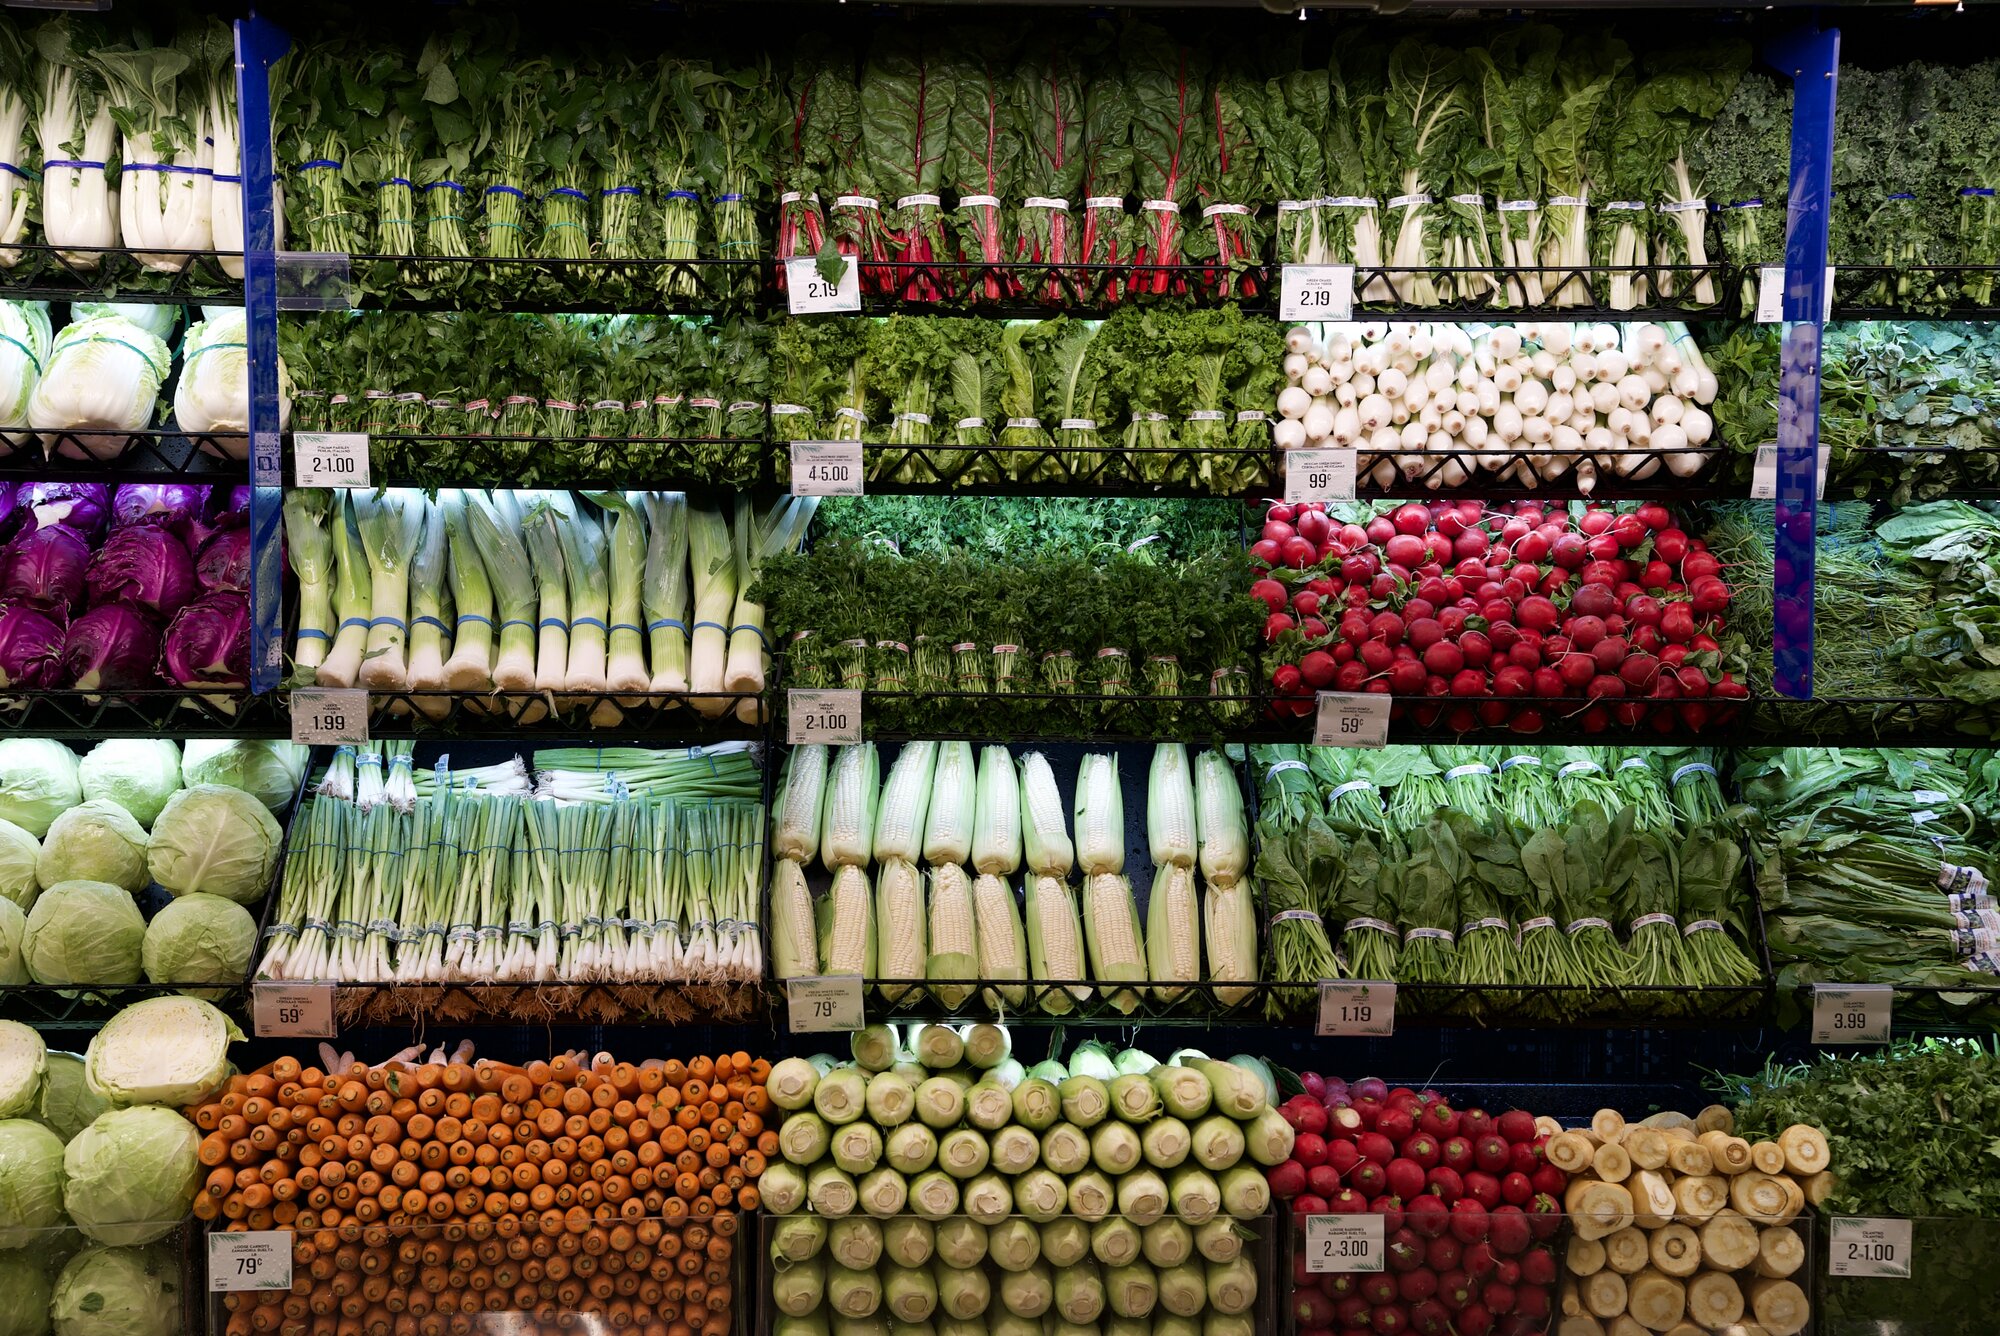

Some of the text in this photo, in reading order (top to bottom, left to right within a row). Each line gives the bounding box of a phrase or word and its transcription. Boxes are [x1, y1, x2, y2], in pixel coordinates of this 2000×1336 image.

[1301, 291, 1329, 305] 2.19
[313, 716, 344, 730] 1.99
[1342, 1007, 1371, 1021] 1.19
[1835, 1013, 1865, 1028] 3.99
